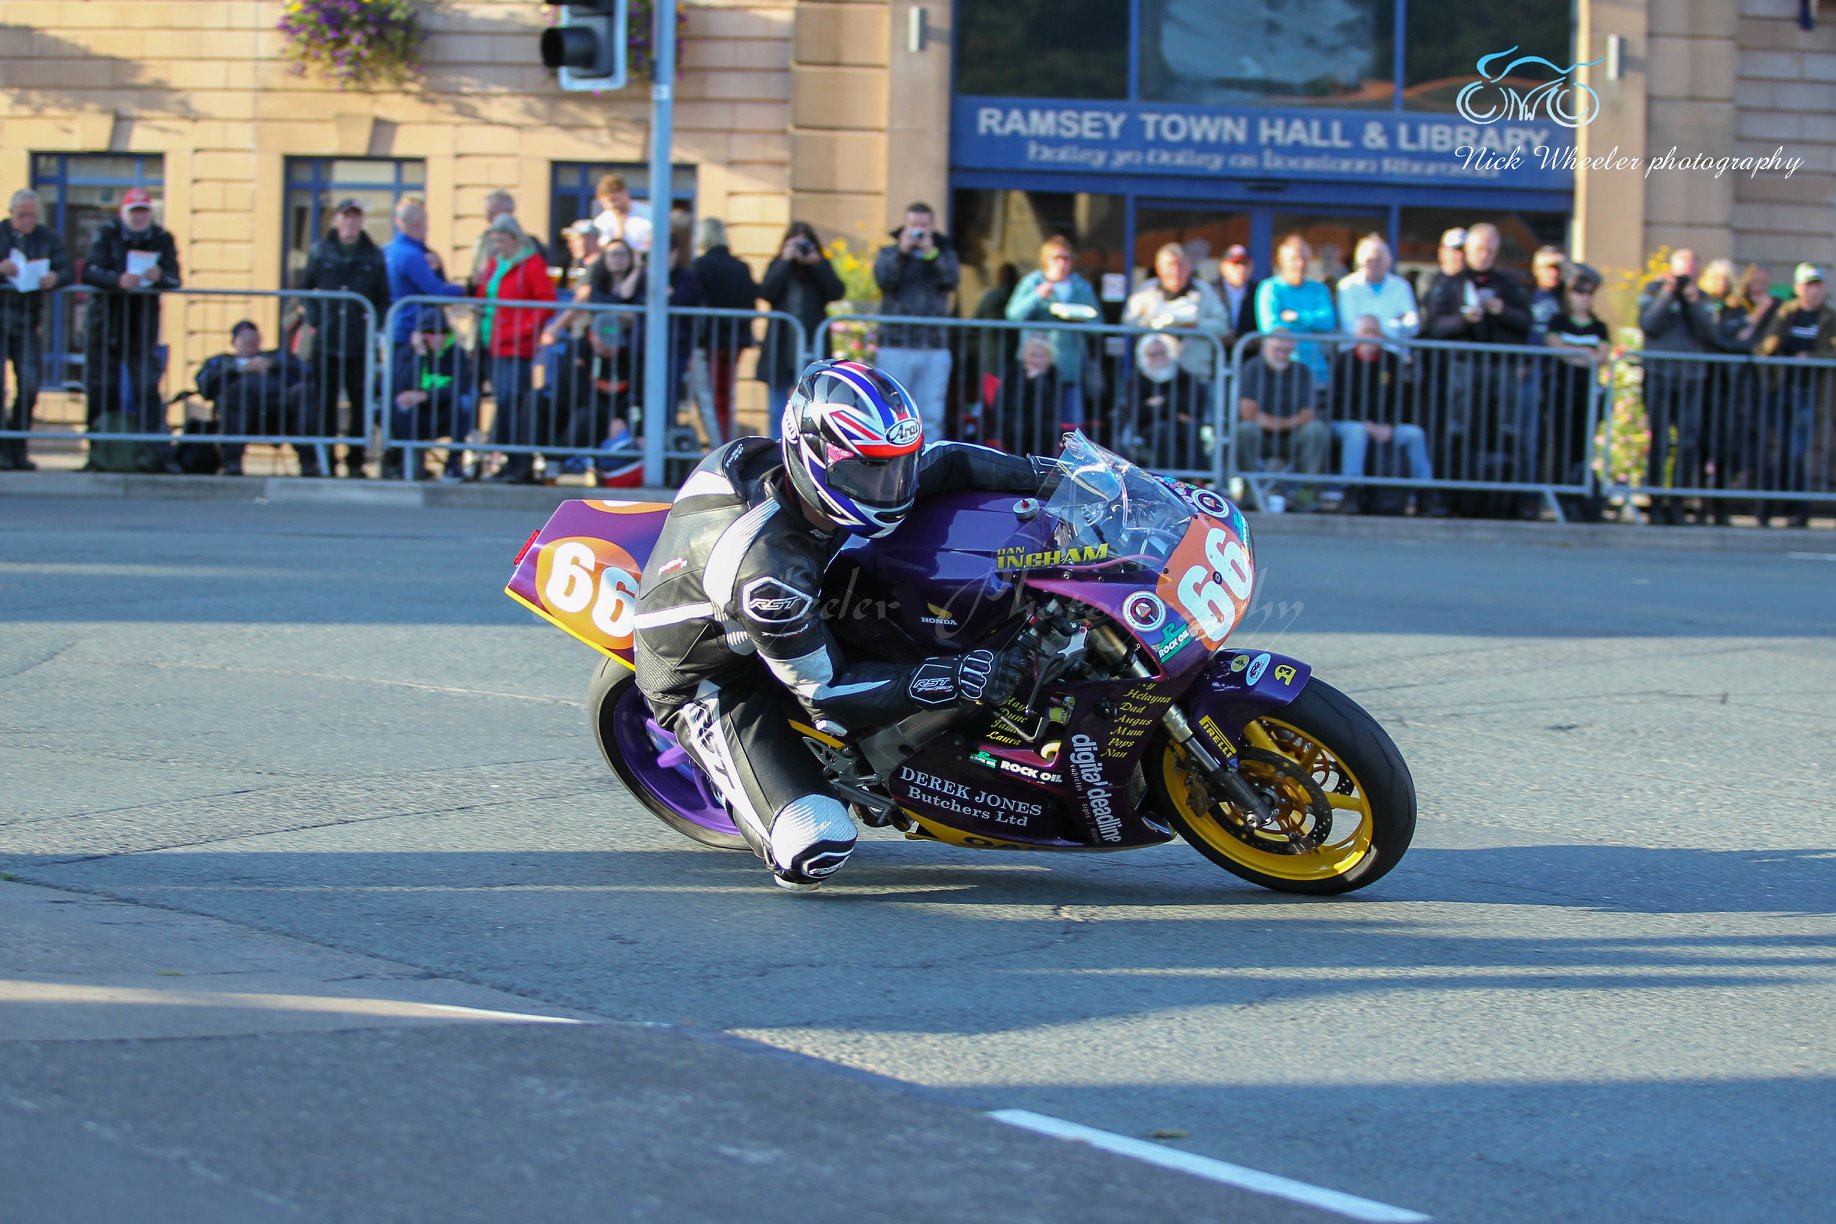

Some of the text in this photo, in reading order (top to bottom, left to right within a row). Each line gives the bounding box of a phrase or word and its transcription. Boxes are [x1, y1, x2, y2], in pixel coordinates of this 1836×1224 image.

[976, 107, 1549, 154] RAMSEY TOWN HALL & LIBRARY
[997, 543, 1109, 569] INGHAM
[545, 541, 640, 638] 66
[1177, 527, 1253, 642] 66
[749, 597, 802, 611] RST
[921, 616, 958, 626] HONDA
[1158, 630, 1191, 659] ROCK OIL
[912, 677, 952, 689] RST
[1119, 701, 1147, 714] Dad
[1114, 714, 1153, 727] Angus
[986, 731, 1022, 746] Laura
[1109, 726, 1145, 737] Mum
[1198, 714, 1238, 759] PIRELLI
[1107, 737, 1135, 749] Pops
[1100, 748, 1128, 759] Nan
[1000, 760, 1063, 783] ROCK OIL
[900, 766, 1043, 816] DEREK JONES
[907, 785, 1029, 828] Butchers Ltd
